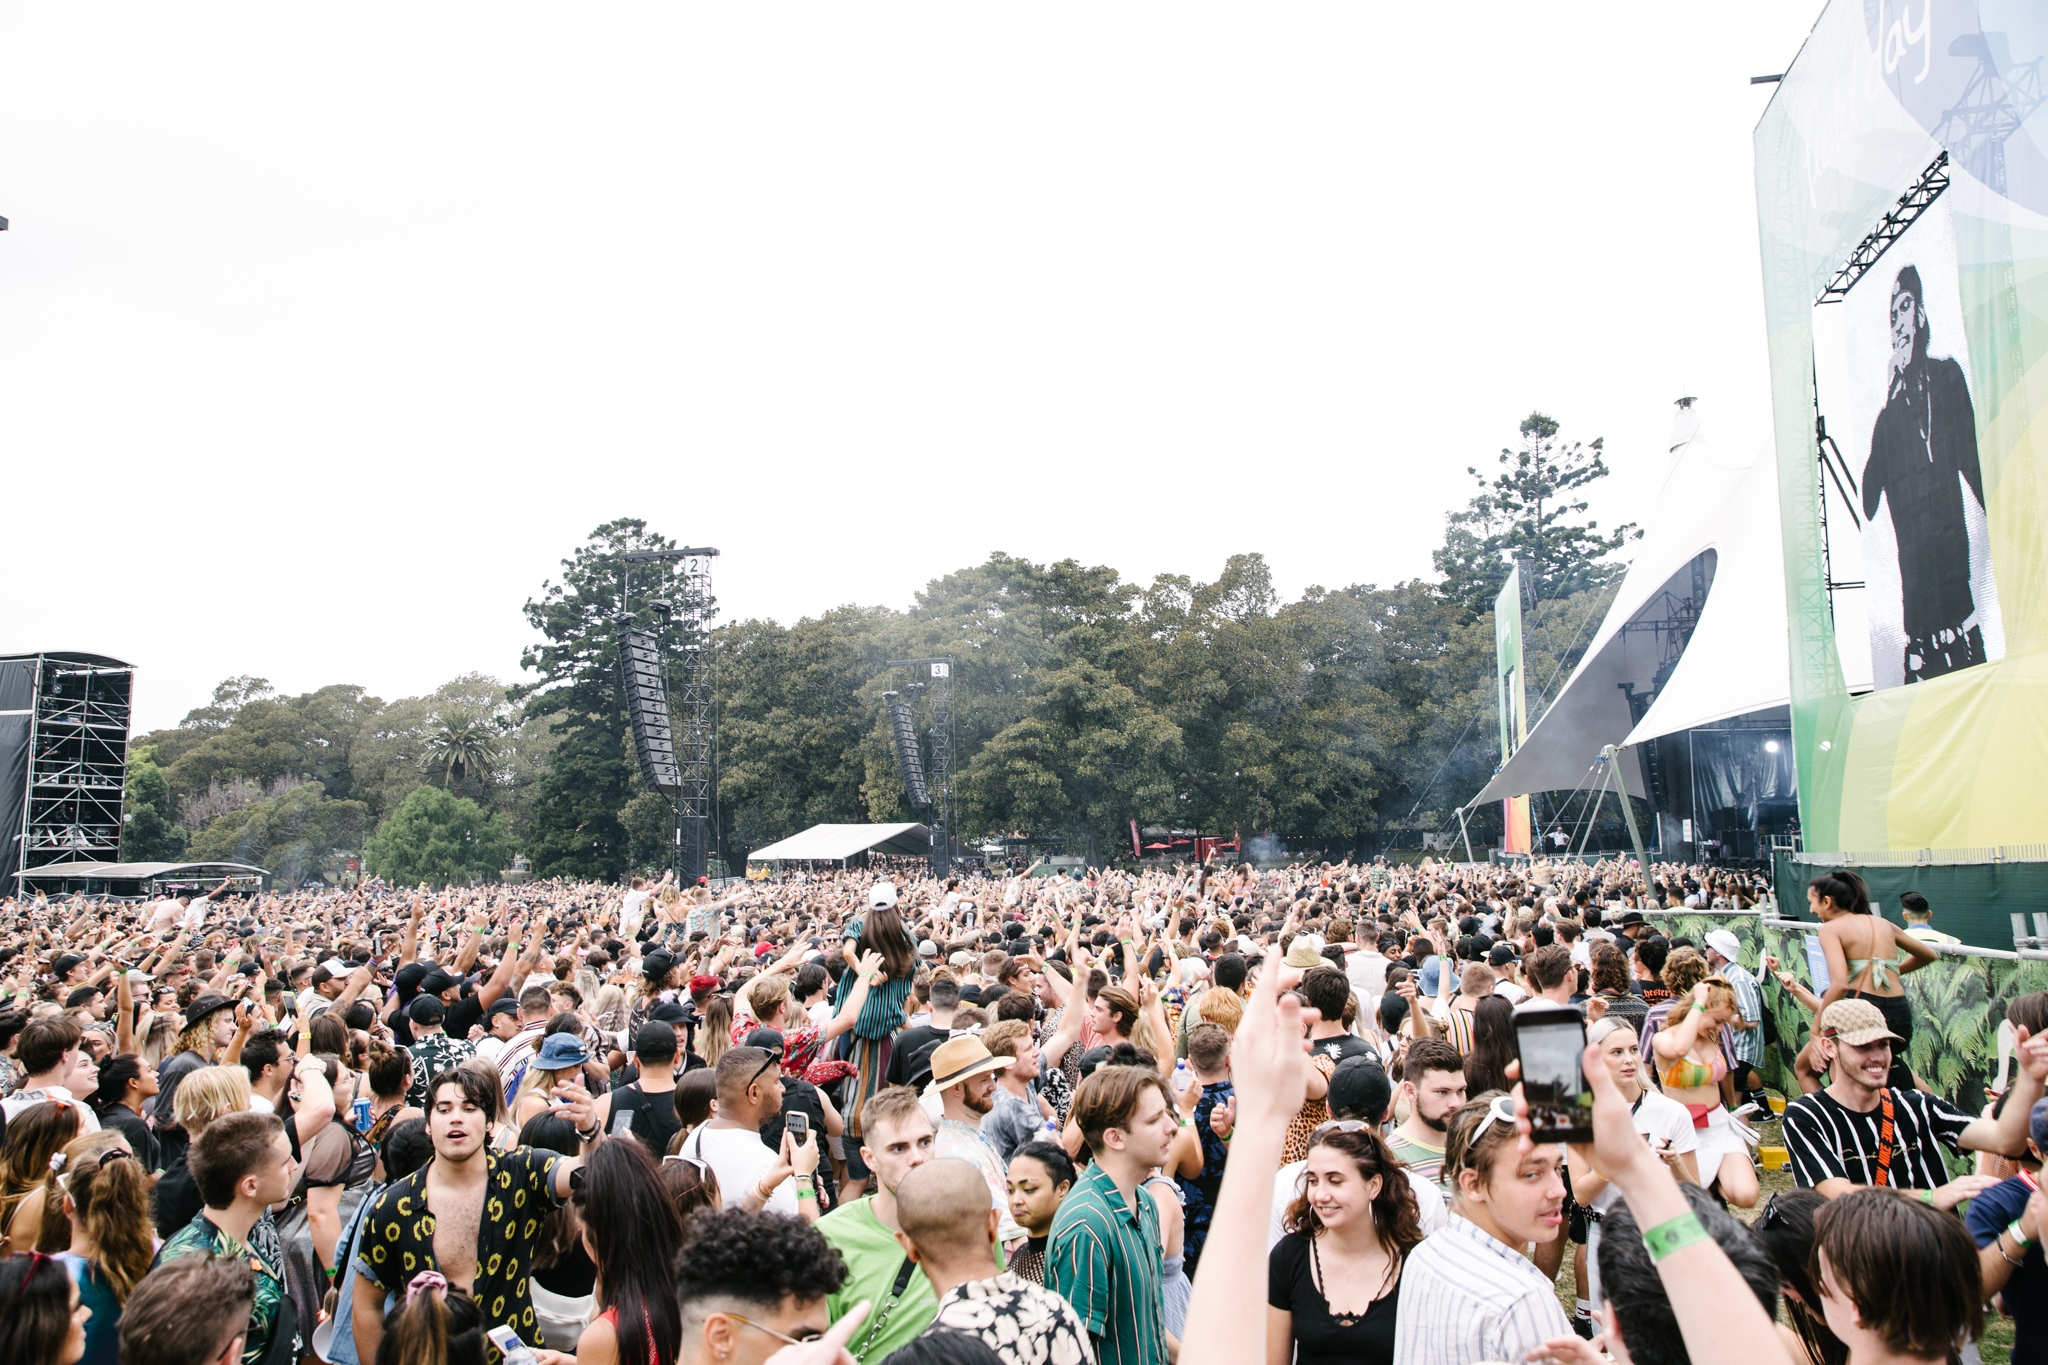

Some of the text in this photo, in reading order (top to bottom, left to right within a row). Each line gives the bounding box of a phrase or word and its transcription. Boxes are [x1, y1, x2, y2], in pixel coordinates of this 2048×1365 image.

[690, 558, 698, 573] 2
[705, 559, 710, 574] 2
[935, 665, 941, 675] 3
[1881, 1118, 1894, 1144] NIKE
[1878, 1142, 1892, 1168] NIKE
